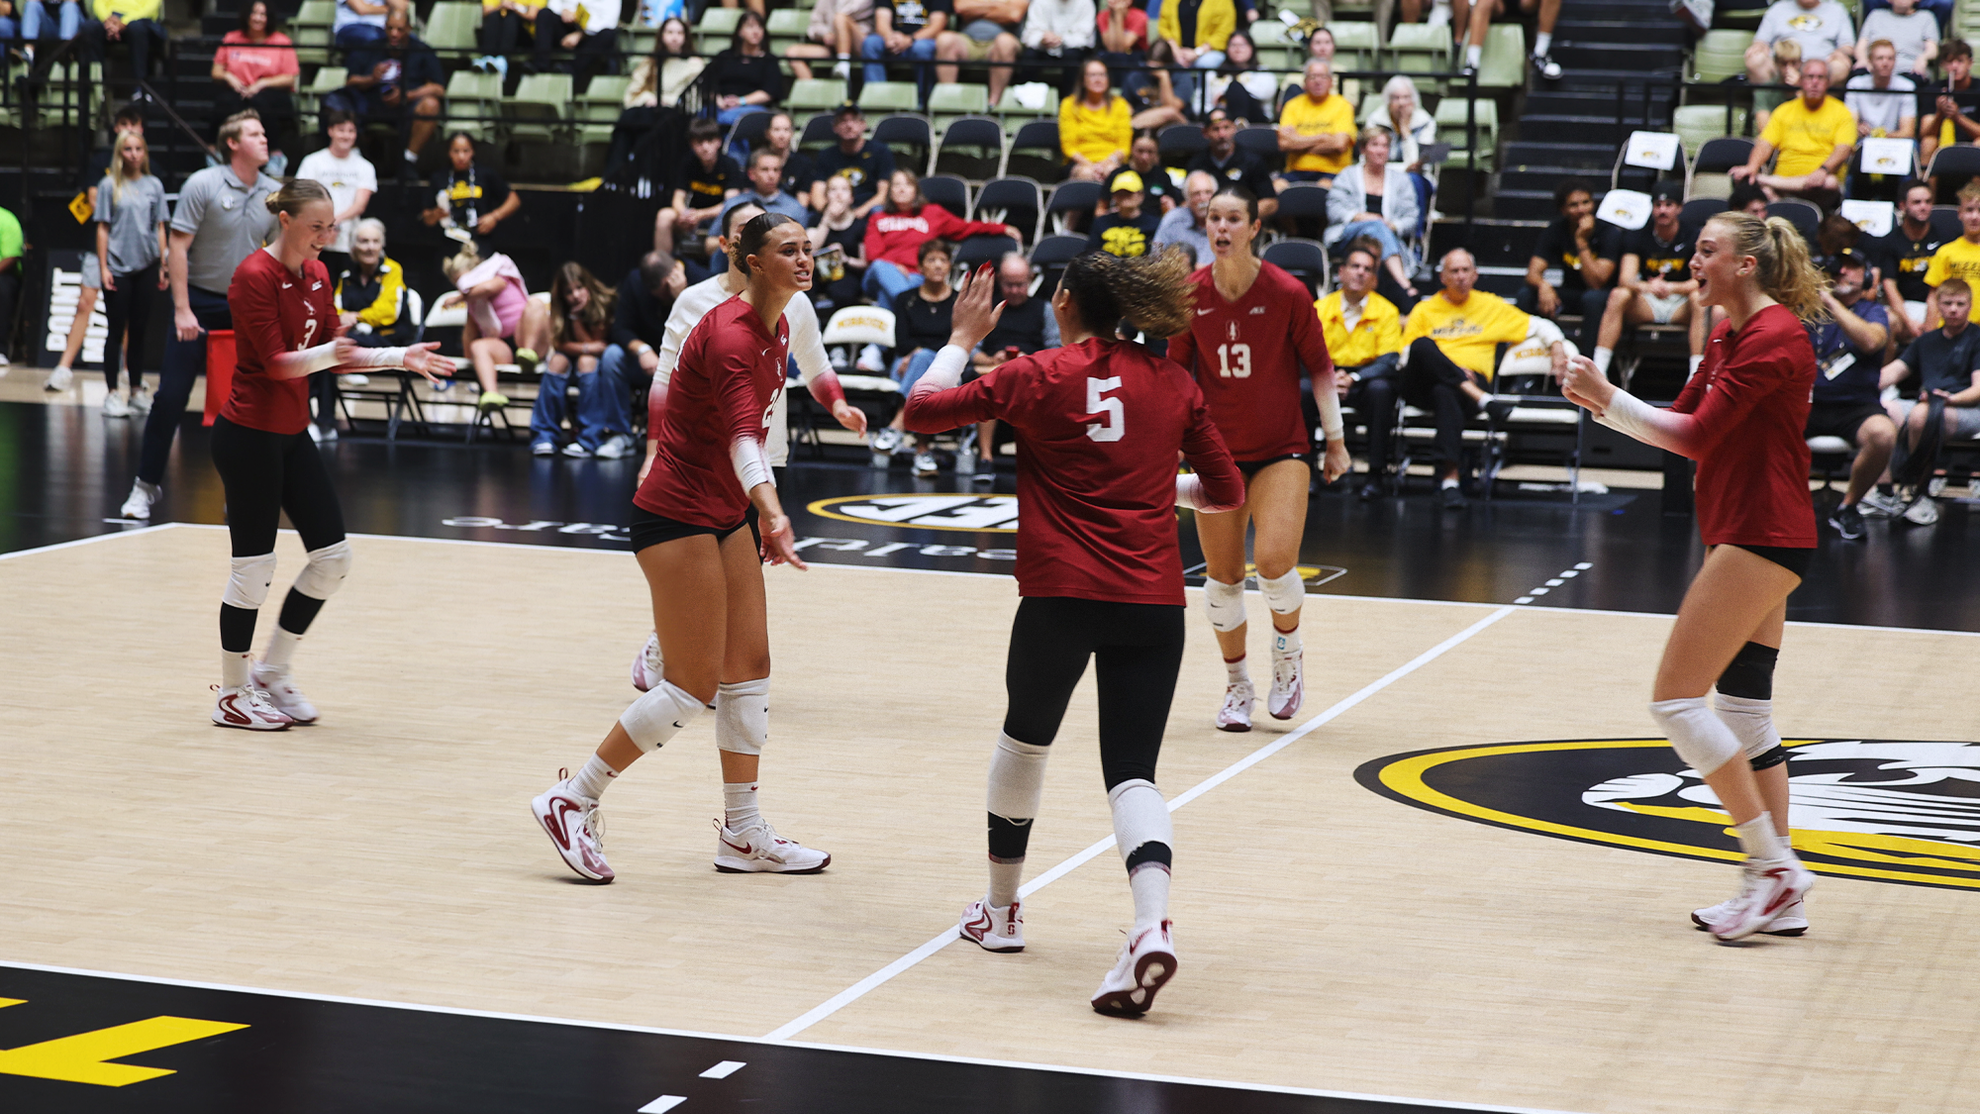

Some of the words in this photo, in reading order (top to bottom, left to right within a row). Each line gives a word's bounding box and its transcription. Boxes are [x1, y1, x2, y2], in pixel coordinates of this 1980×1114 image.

[46, 267, 83, 352] POINT
[298, 319, 318, 352] 3
[1217, 343, 1252, 378] 13
[1086, 375, 1126, 442] 5
[839, 496, 1019, 530] EC
[792, 536, 1017, 561] ealt
